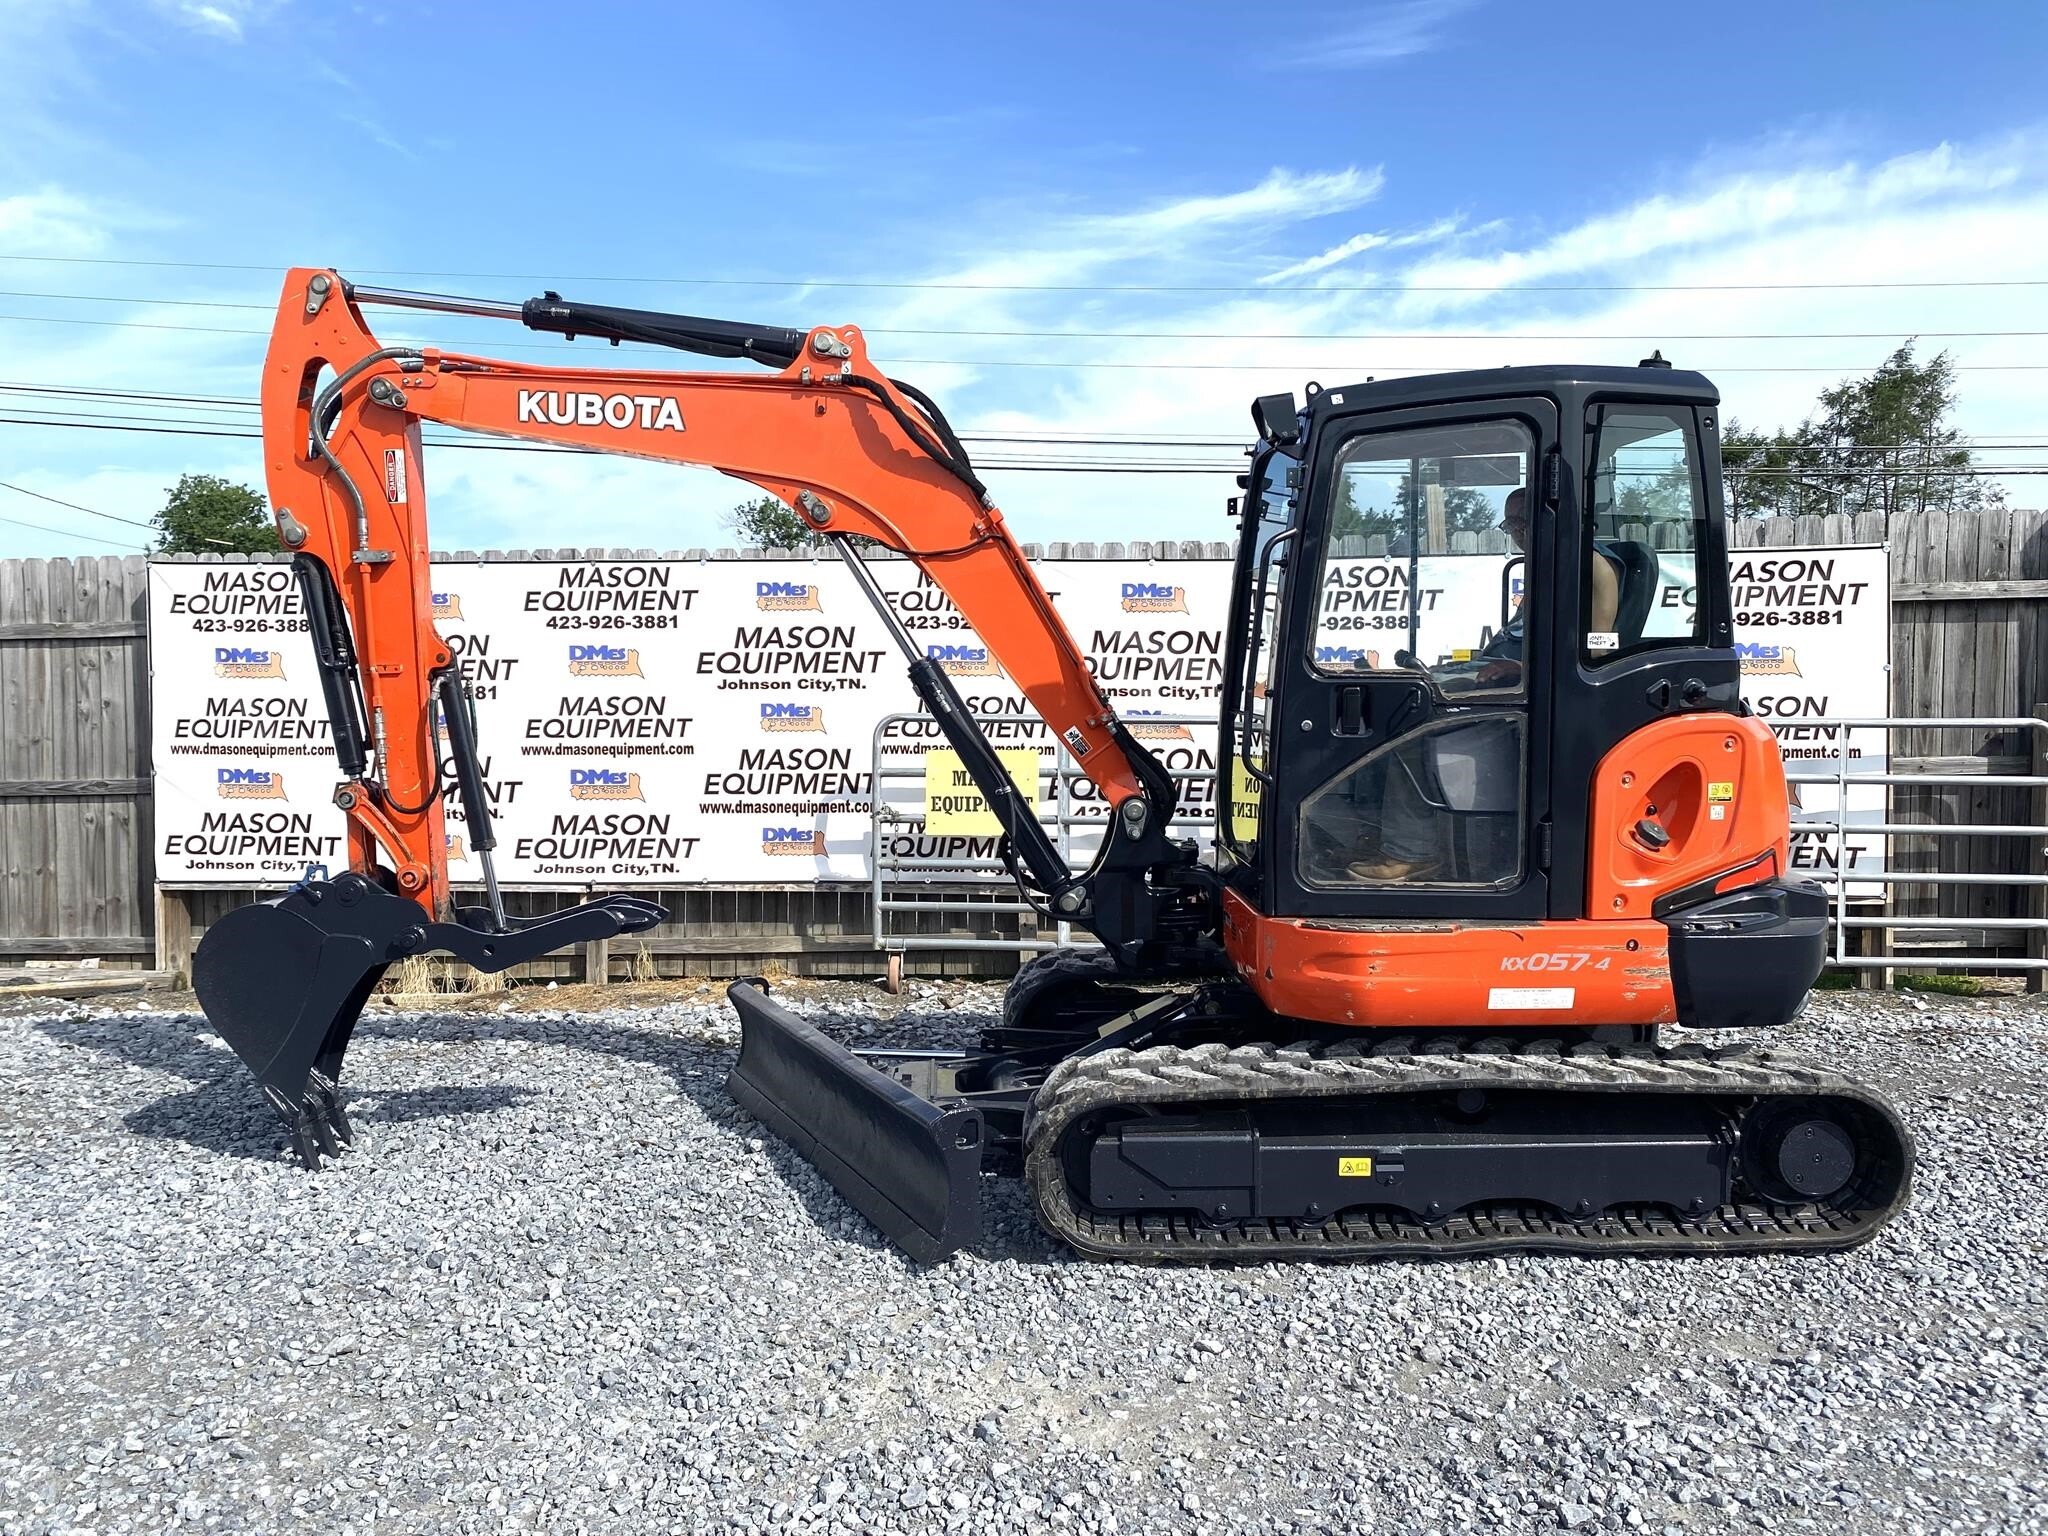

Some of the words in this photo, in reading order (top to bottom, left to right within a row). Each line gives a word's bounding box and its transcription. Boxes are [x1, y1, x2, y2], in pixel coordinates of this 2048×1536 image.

[518, 389, 687, 432] KUBOTA
[558, 566, 671, 588] MASON
[1323, 565, 1410, 589] ASON
[1729, 559, 1835, 583] ASON
[169, 593, 307, 615] EQUIPME
[523, 589, 699, 612] EQUIPMENT
[1324, 588, 1445, 613] IPMENT
[192, 618, 310, 633] 423-926-388
[545, 615, 679, 630] 423-926-3881
[1319, 615, 1421, 631] -926-3881
[733, 626, 856, 650] MASON
[1090, 629, 1222, 655] MASON
[695, 651, 887, 675] EQUIPMENT
[1083, 655, 1223, 681] QUIPMEN
[716, 678, 791, 690] Johnson
[796, 678, 867, 692] City,TN.
[1157, 685, 1222, 701] City,T
[205, 697, 308, 718] MASON
[558, 696, 666, 716] MASON
[917, 695, 1027, 715] SON
[1740, 695, 1829, 718] SON
[174, 719, 332, 739] EQUIPMENT
[525, 718, 694, 739] EQUIPMENT
[170, 742, 335, 759] www.dmasonequipment.com
[520, 742, 695, 759] www.dmasonequipment.com
[738, 748, 852, 771] MASON
[703, 772, 873, 795] EQUIPMENT
[699, 799, 873, 817] www.dmasonequipment.co
[200, 811, 313, 834] MASON
[551, 814, 671, 836] MASON
[164, 834, 343, 857] EQUIPMENT
[513, 837, 700, 859] EQUIPMENT
[184, 859, 255, 871] Johnson
[260, 859, 320, 872] City,T
[532, 862, 607, 875] Johnson
[611, 863, 680, 876] City,TN.
[1500, 953, 1612, 972] KX057-4
